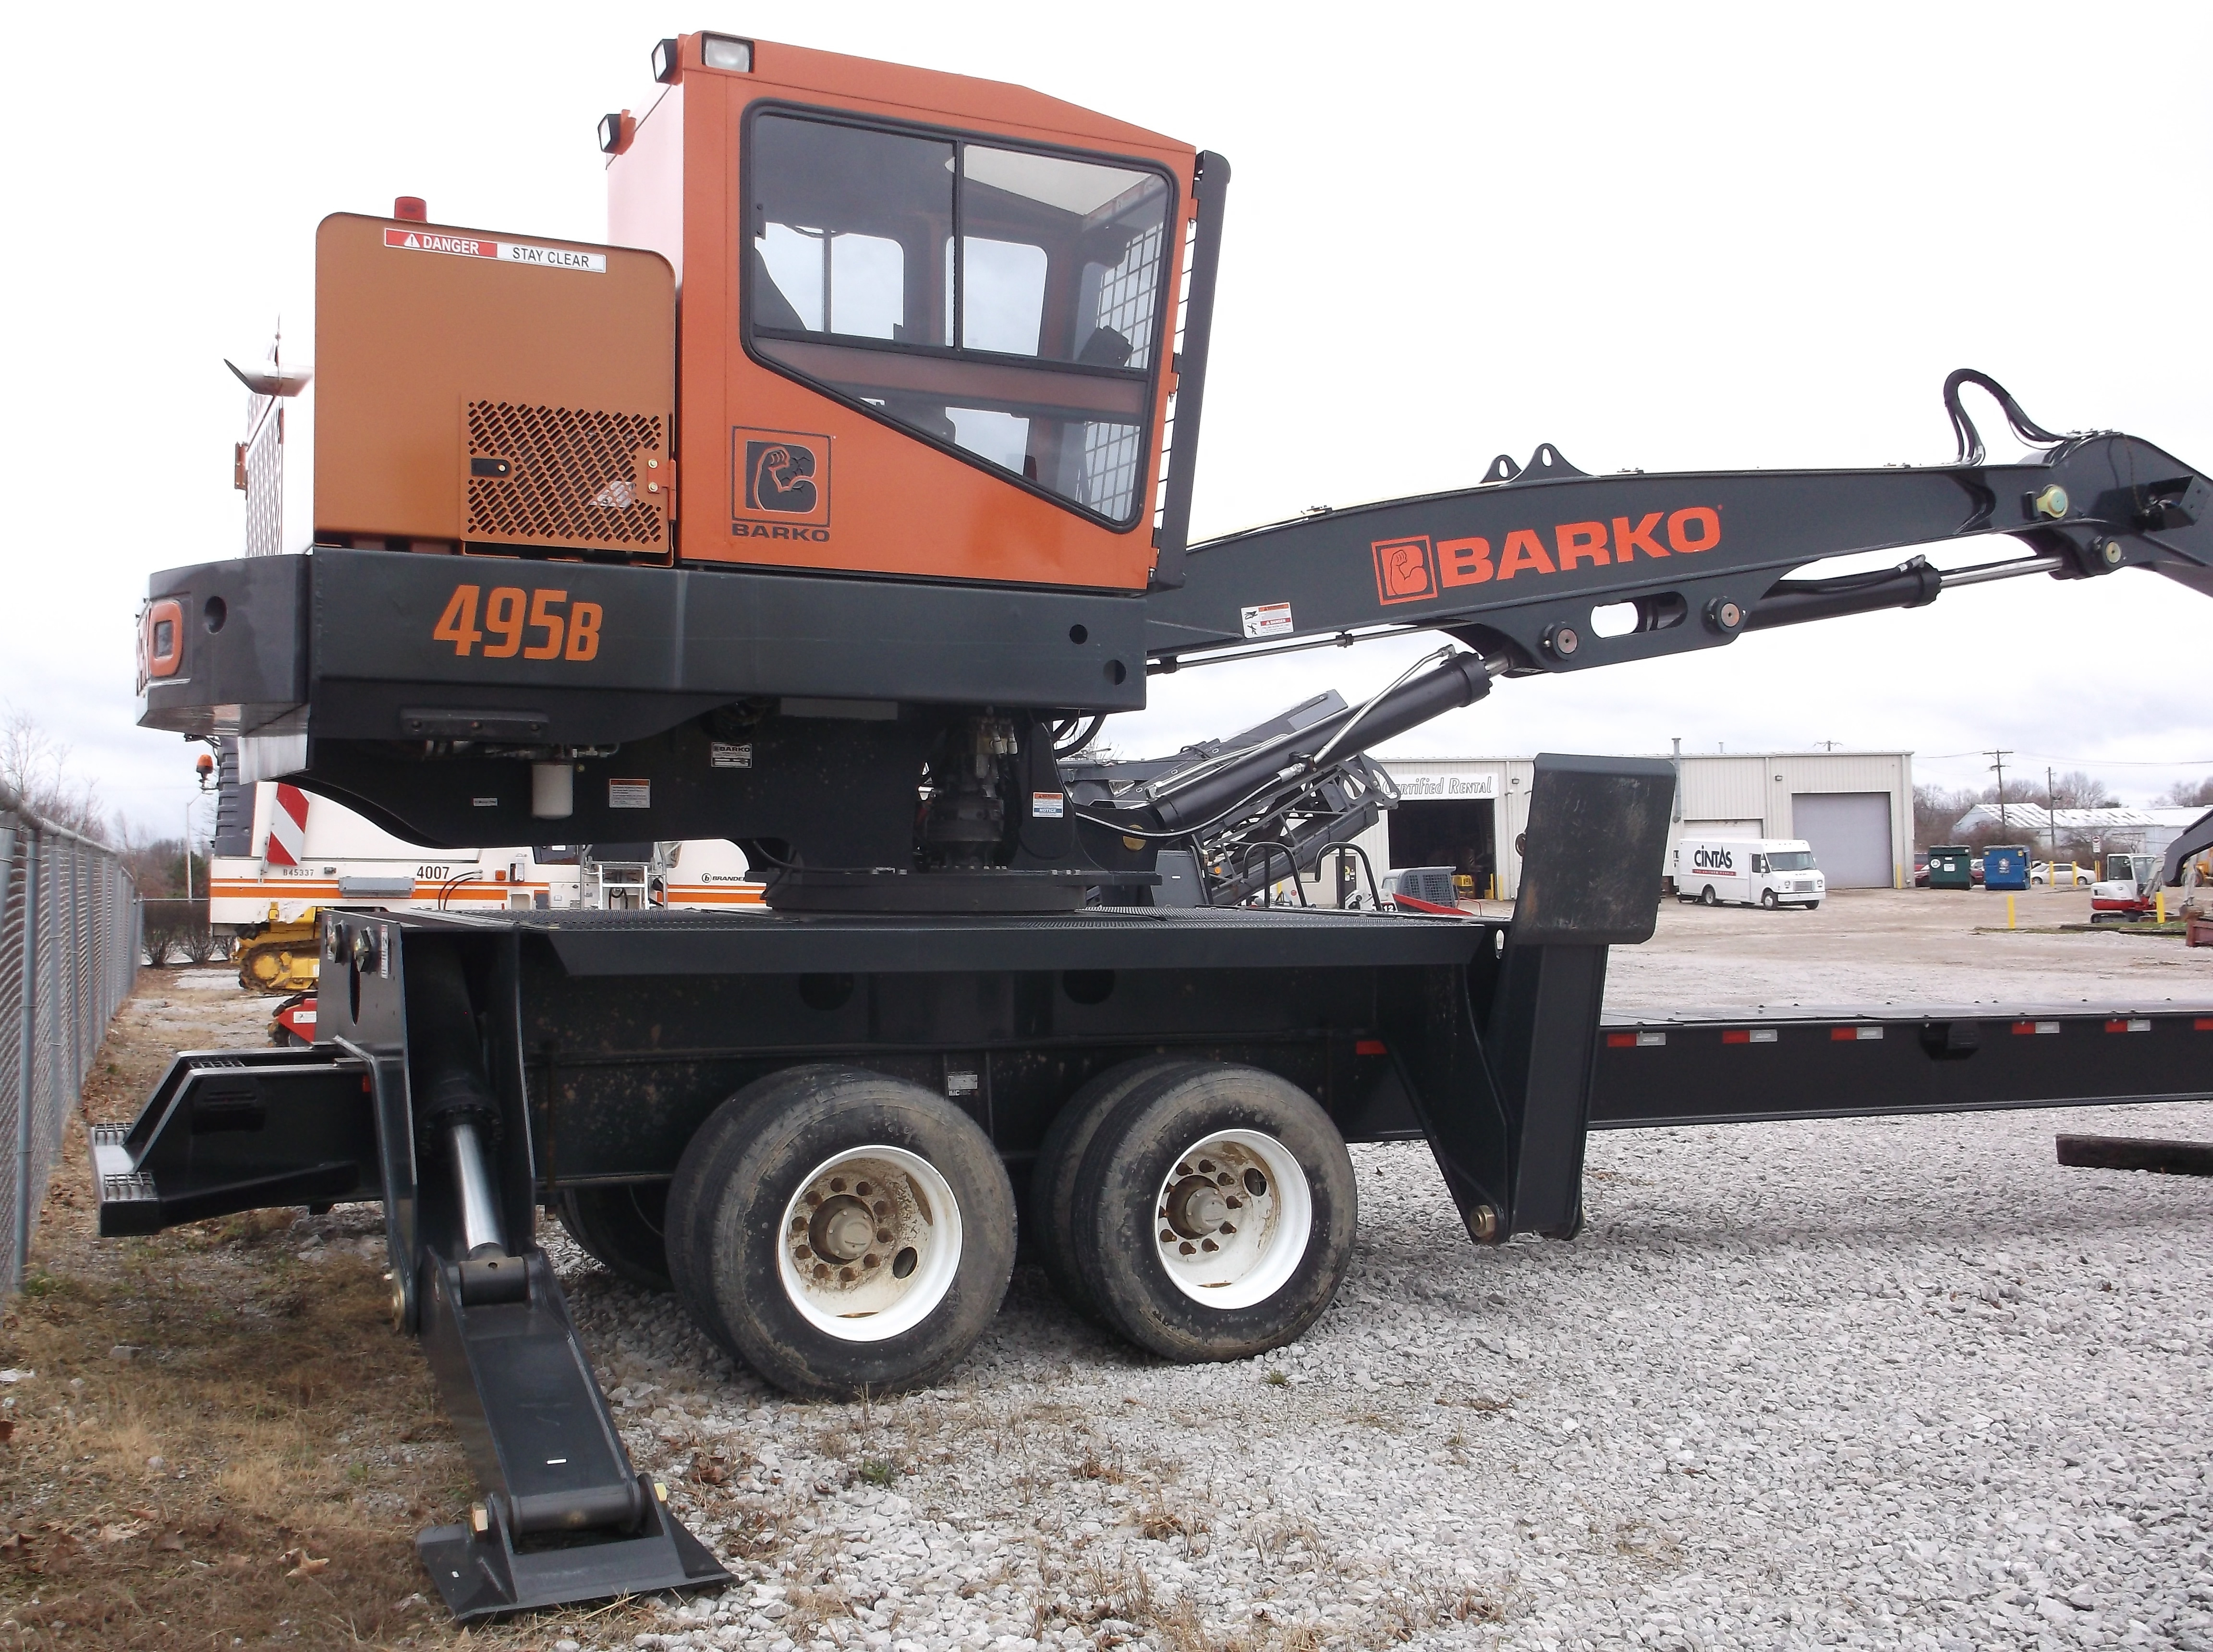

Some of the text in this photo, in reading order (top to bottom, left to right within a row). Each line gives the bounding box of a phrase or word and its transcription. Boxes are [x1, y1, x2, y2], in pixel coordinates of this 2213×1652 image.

[423, 235, 589, 268] DANGER STAY CLEAR
[732, 523, 830, 543] BARKO
[1435, 507, 1722, 589] BARKO
[433, 584, 603, 661] 495B
[283, 868, 314, 876] B45337
[416, 865, 450, 880] 4007
